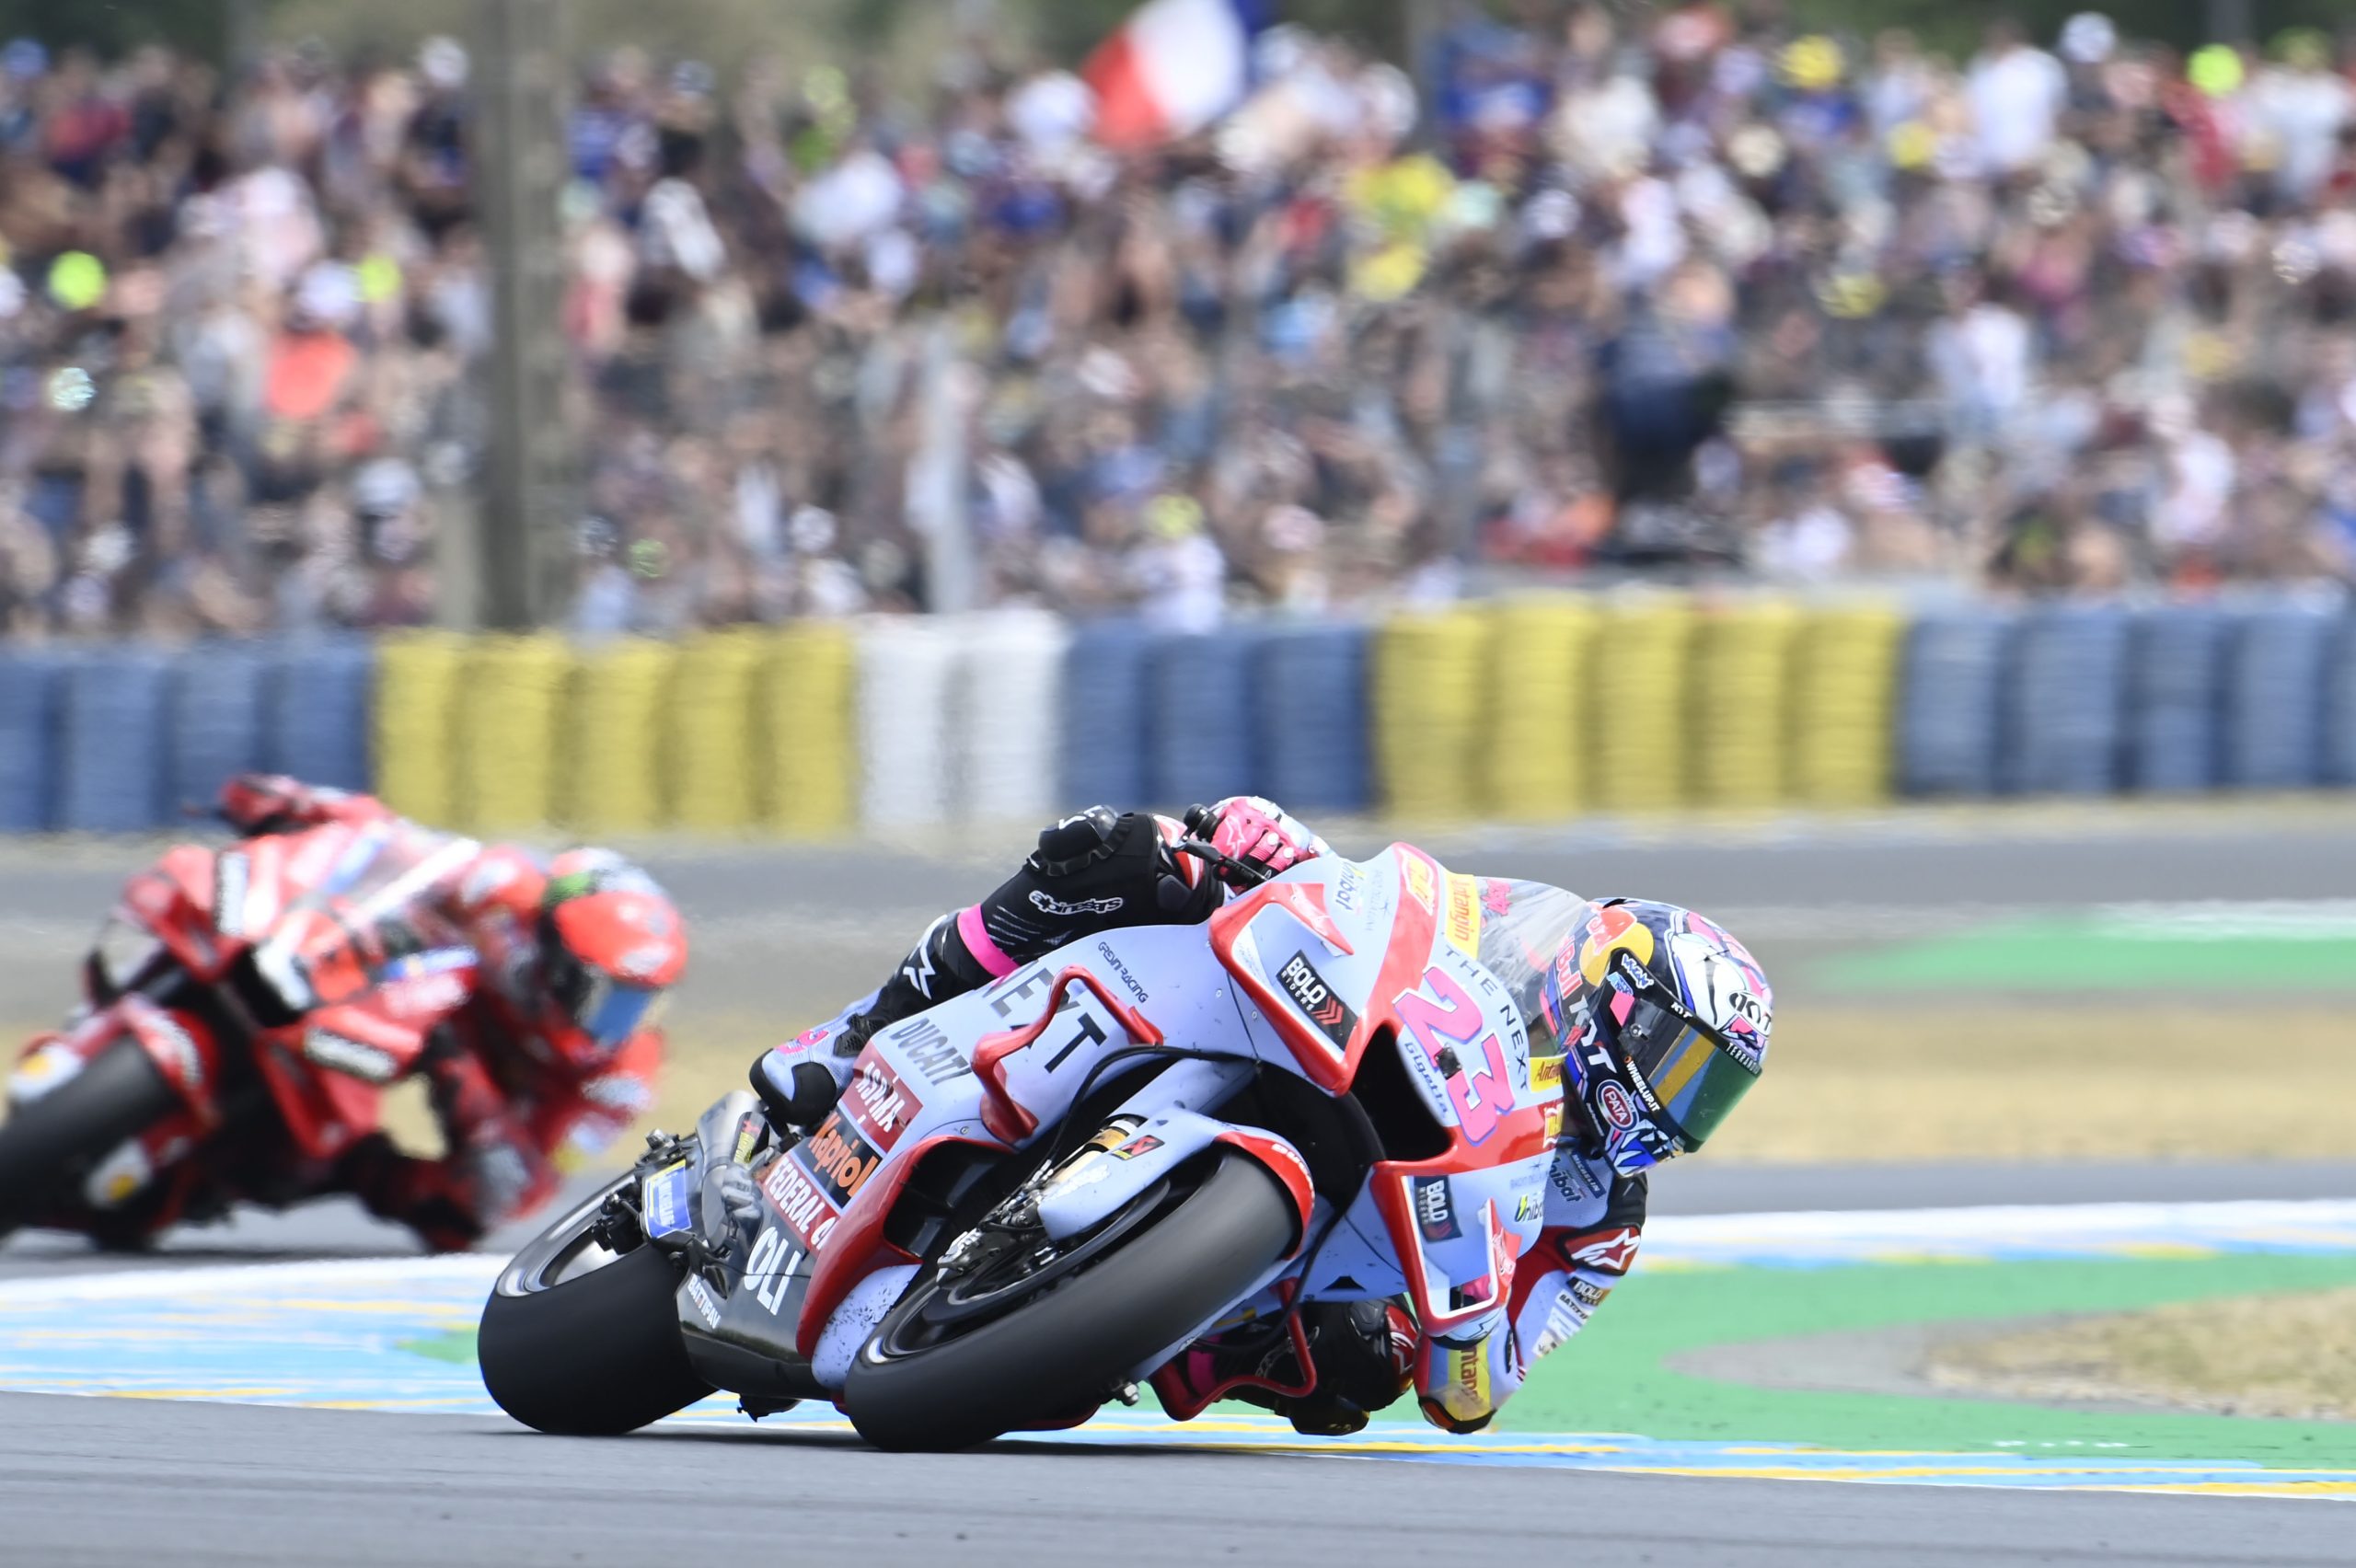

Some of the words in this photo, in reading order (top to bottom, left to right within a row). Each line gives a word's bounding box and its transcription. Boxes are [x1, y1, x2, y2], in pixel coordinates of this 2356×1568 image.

[1286, 956, 1327, 1005] BOLD
[1670, 1001, 1693, 1019] KYT
[982, 959, 1107, 1075] EXT
[1445, 944, 1498, 997] THE
[1499, 1004, 1530, 1090] NEXT
[889, 1018, 973, 1087] DUCATI
[1391, 963, 1516, 1147] 23
[1604, 1090, 1628, 1124] PATA
[764, 1156, 826, 1235] FEDERAL
[1426, 1180, 1449, 1224] BOLD
